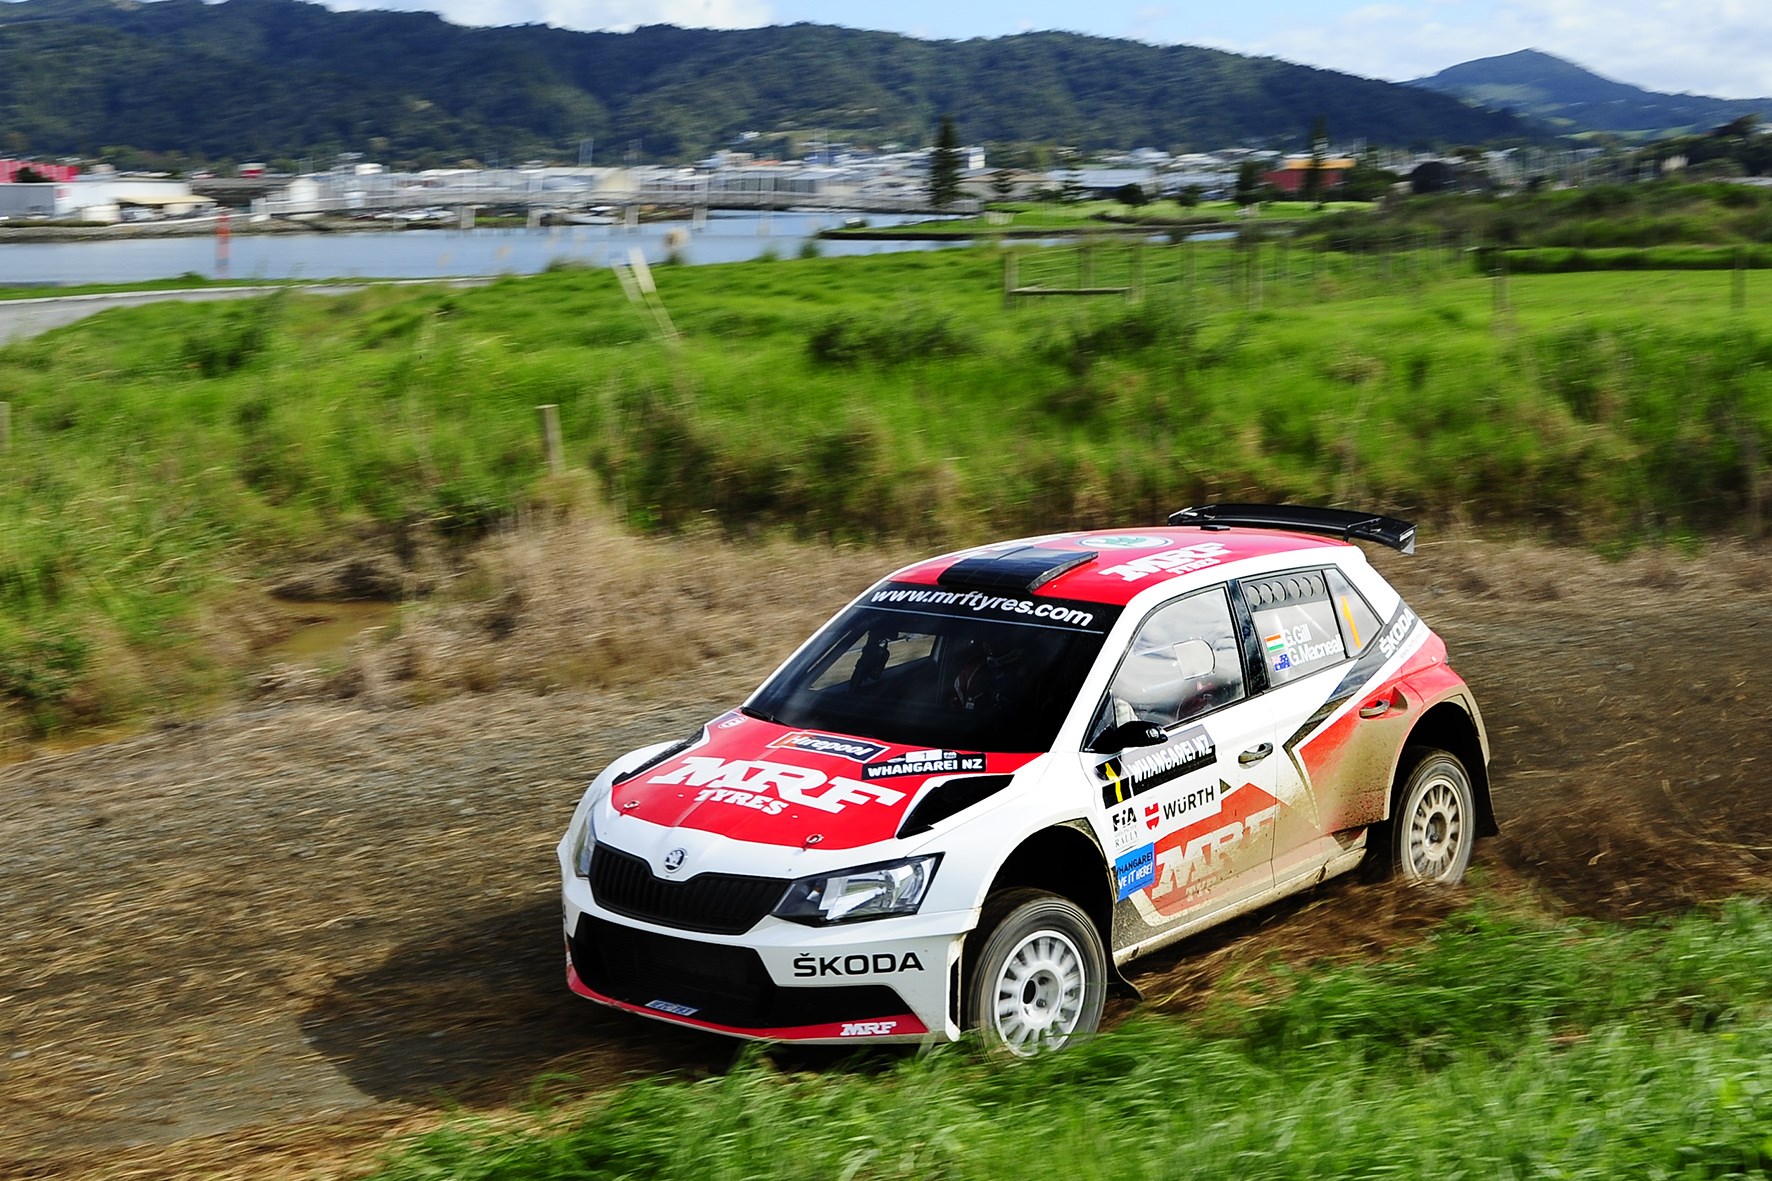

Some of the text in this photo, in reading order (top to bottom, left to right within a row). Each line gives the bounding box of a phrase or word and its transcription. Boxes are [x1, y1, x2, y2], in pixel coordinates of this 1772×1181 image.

[1098, 542, 1232, 582] MRF
[871, 590, 1094, 627] www.mrftyres.com
[1282, 623, 1312, 648] G.Gill
[1378, 607, 1416, 660] ŠKODA
[782, 736, 875, 756] Hirepool
[1126, 734, 1213, 784] WHANGAREI NZ
[867, 758, 983, 778] WHANGAREI NZ
[646, 756, 908, 814] MRF
[693, 788, 790, 815] TYRES
[1163, 785, 1215, 820] WÜRTH
[1117, 851, 1153, 876] HANGAREI
[1151, 803, 1280, 900] MRF
[793, 952, 925, 977] ŠKODA
[840, 1021, 897, 1037] MRF
